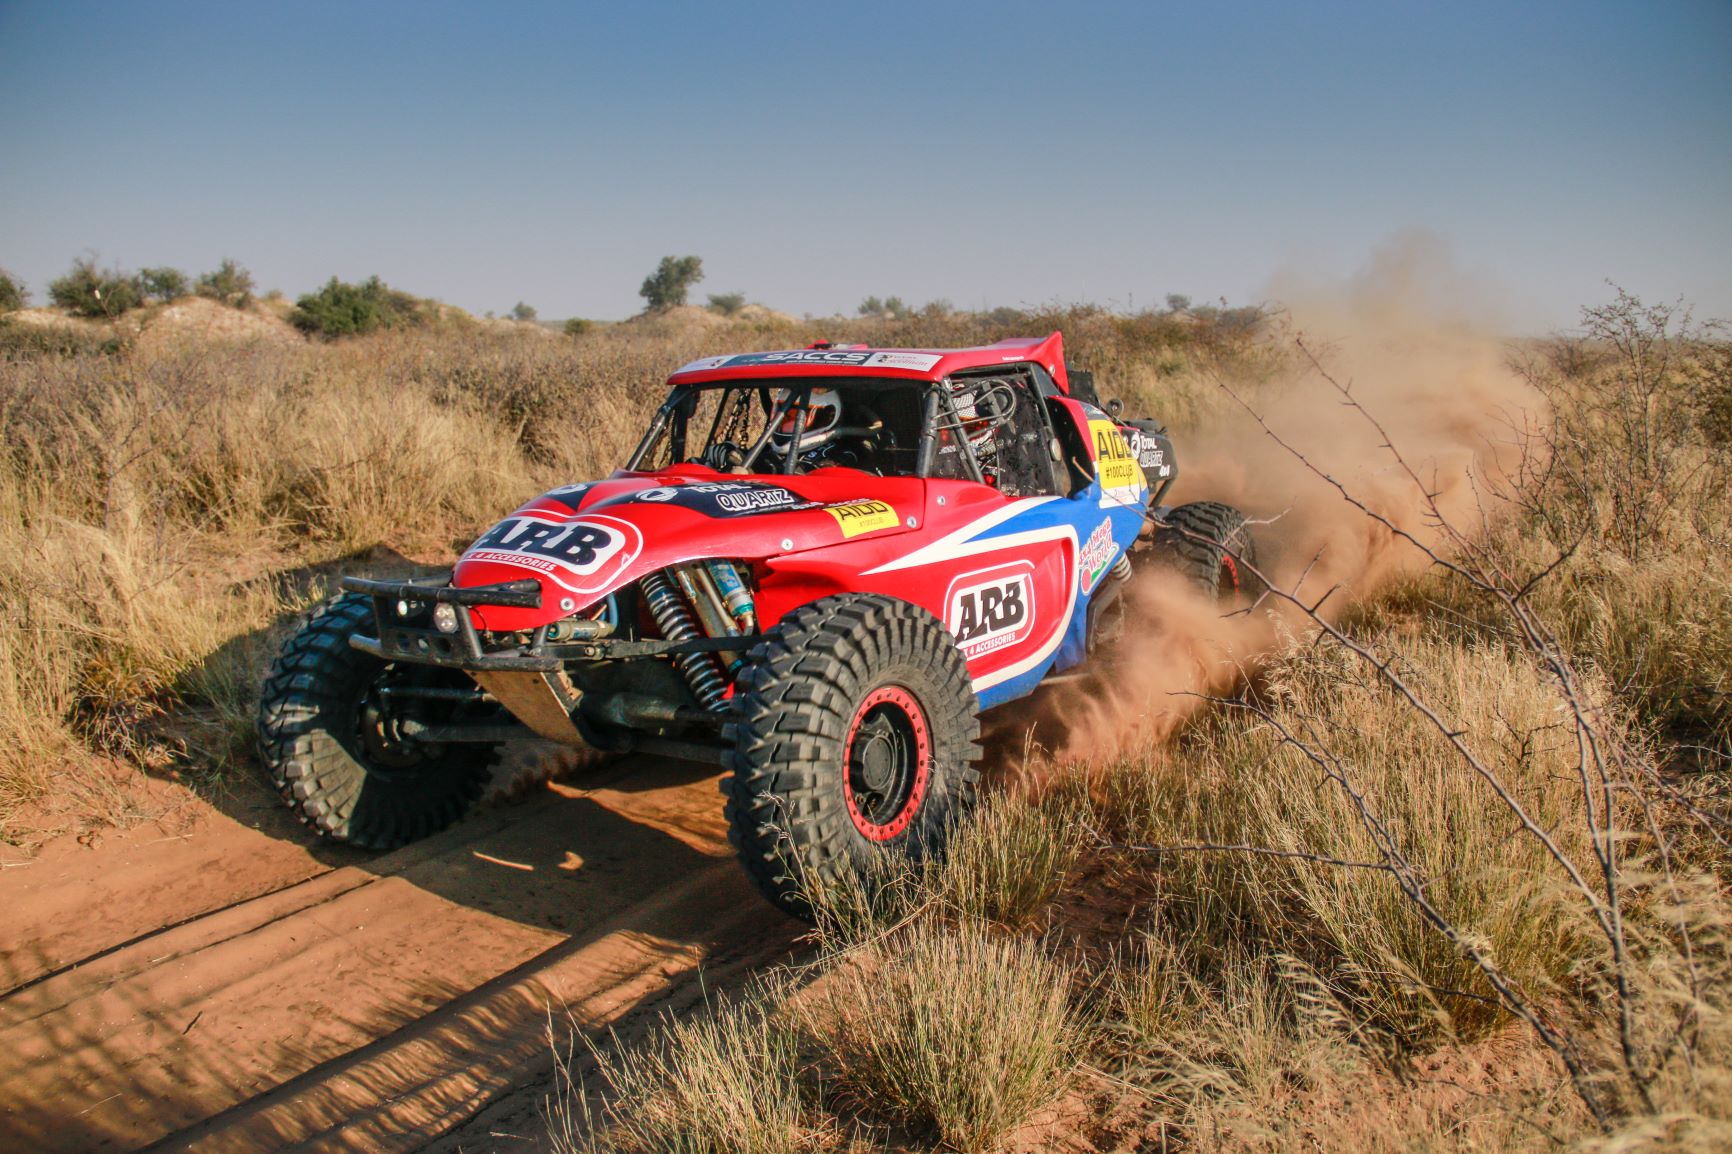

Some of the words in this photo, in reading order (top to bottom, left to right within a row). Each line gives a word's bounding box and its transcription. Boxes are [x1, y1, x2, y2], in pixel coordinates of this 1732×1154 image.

[763, 352, 870, 361] SACCS
[1105, 464, 1134, 479] #100CLUB
[684, 483, 752, 493] TOTAL
[716, 489, 796, 511] QUARTZ
[475, 519, 612, 566] ARB
[484, 552, 558, 572] ACCESSORIES
[954, 581, 1025, 646] ARB
[969, 647, 976, 656] 4
[975, 632, 1017, 654] ACCESSORIES
